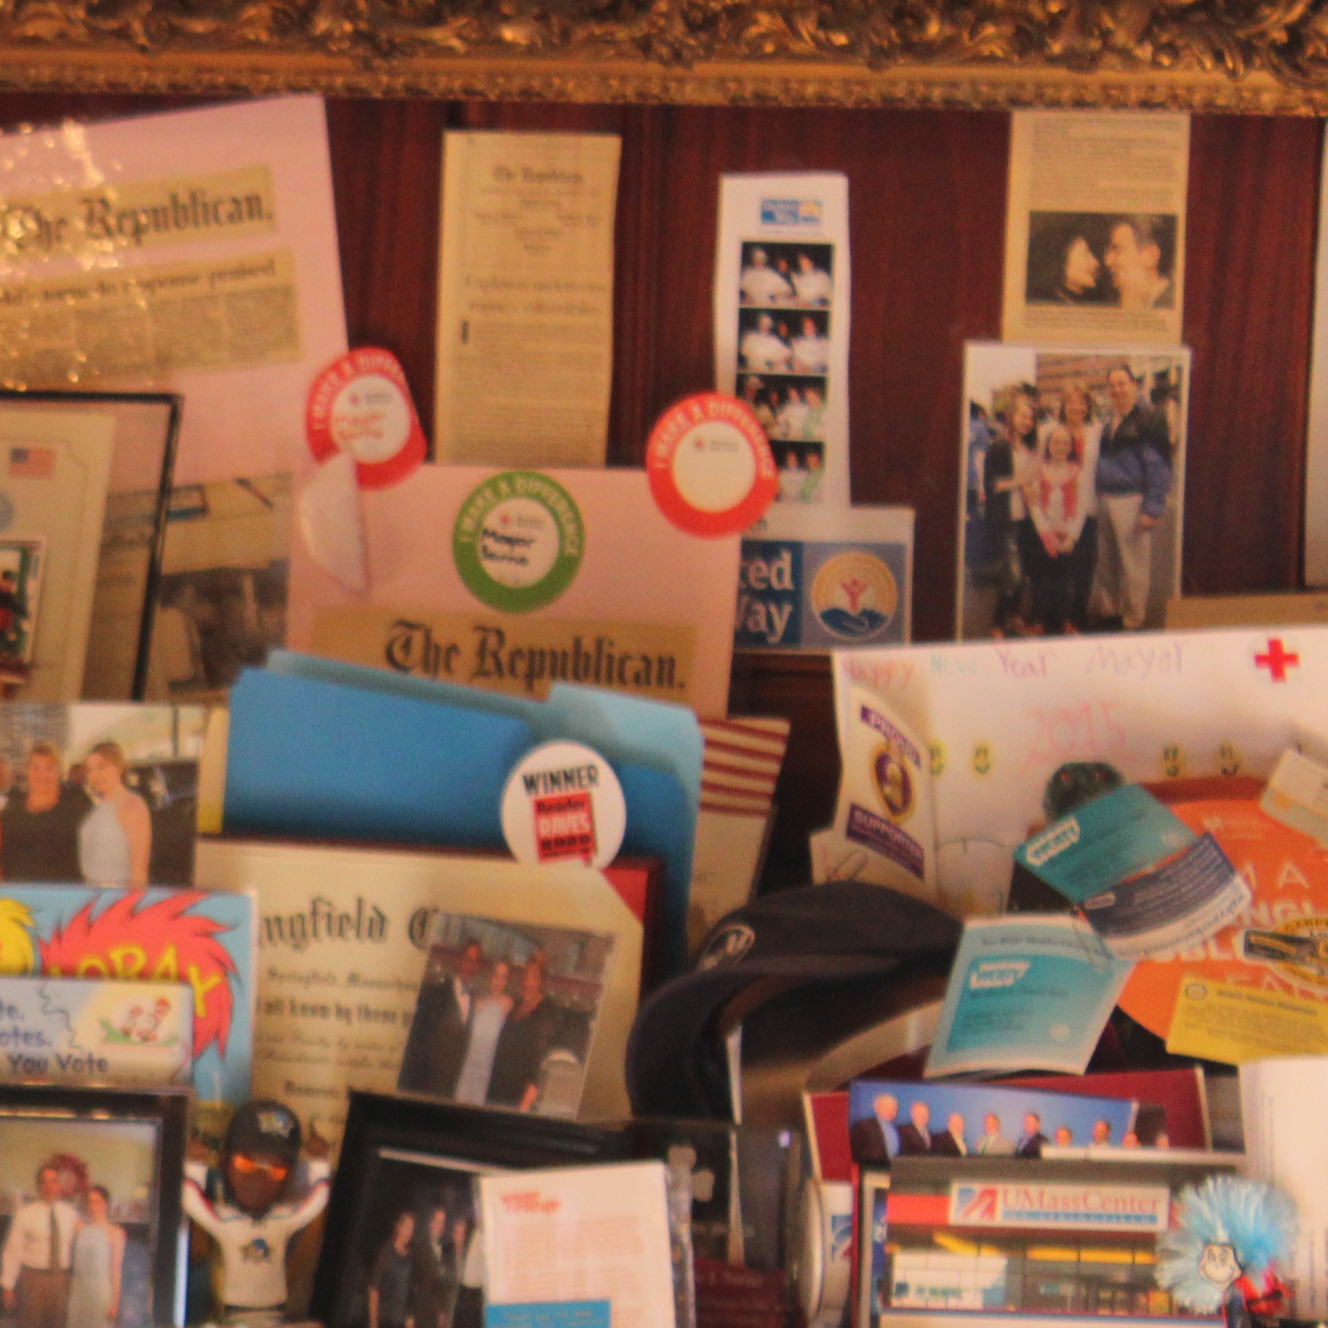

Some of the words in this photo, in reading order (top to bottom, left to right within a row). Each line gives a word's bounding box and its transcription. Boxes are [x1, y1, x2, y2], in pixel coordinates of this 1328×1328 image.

[741, 546, 794, 592] ted
[385, 620, 460, 677] The
[471, 624, 687, 693] Republican.
[522, 765, 600, 796] WINNER
[260, 896, 388, 952] ngfield
[8, 1051, 50, 1076] You
[56, 1052, 109, 1075] Vote
[1001, 1187, 1159, 1213] UMassCenter
